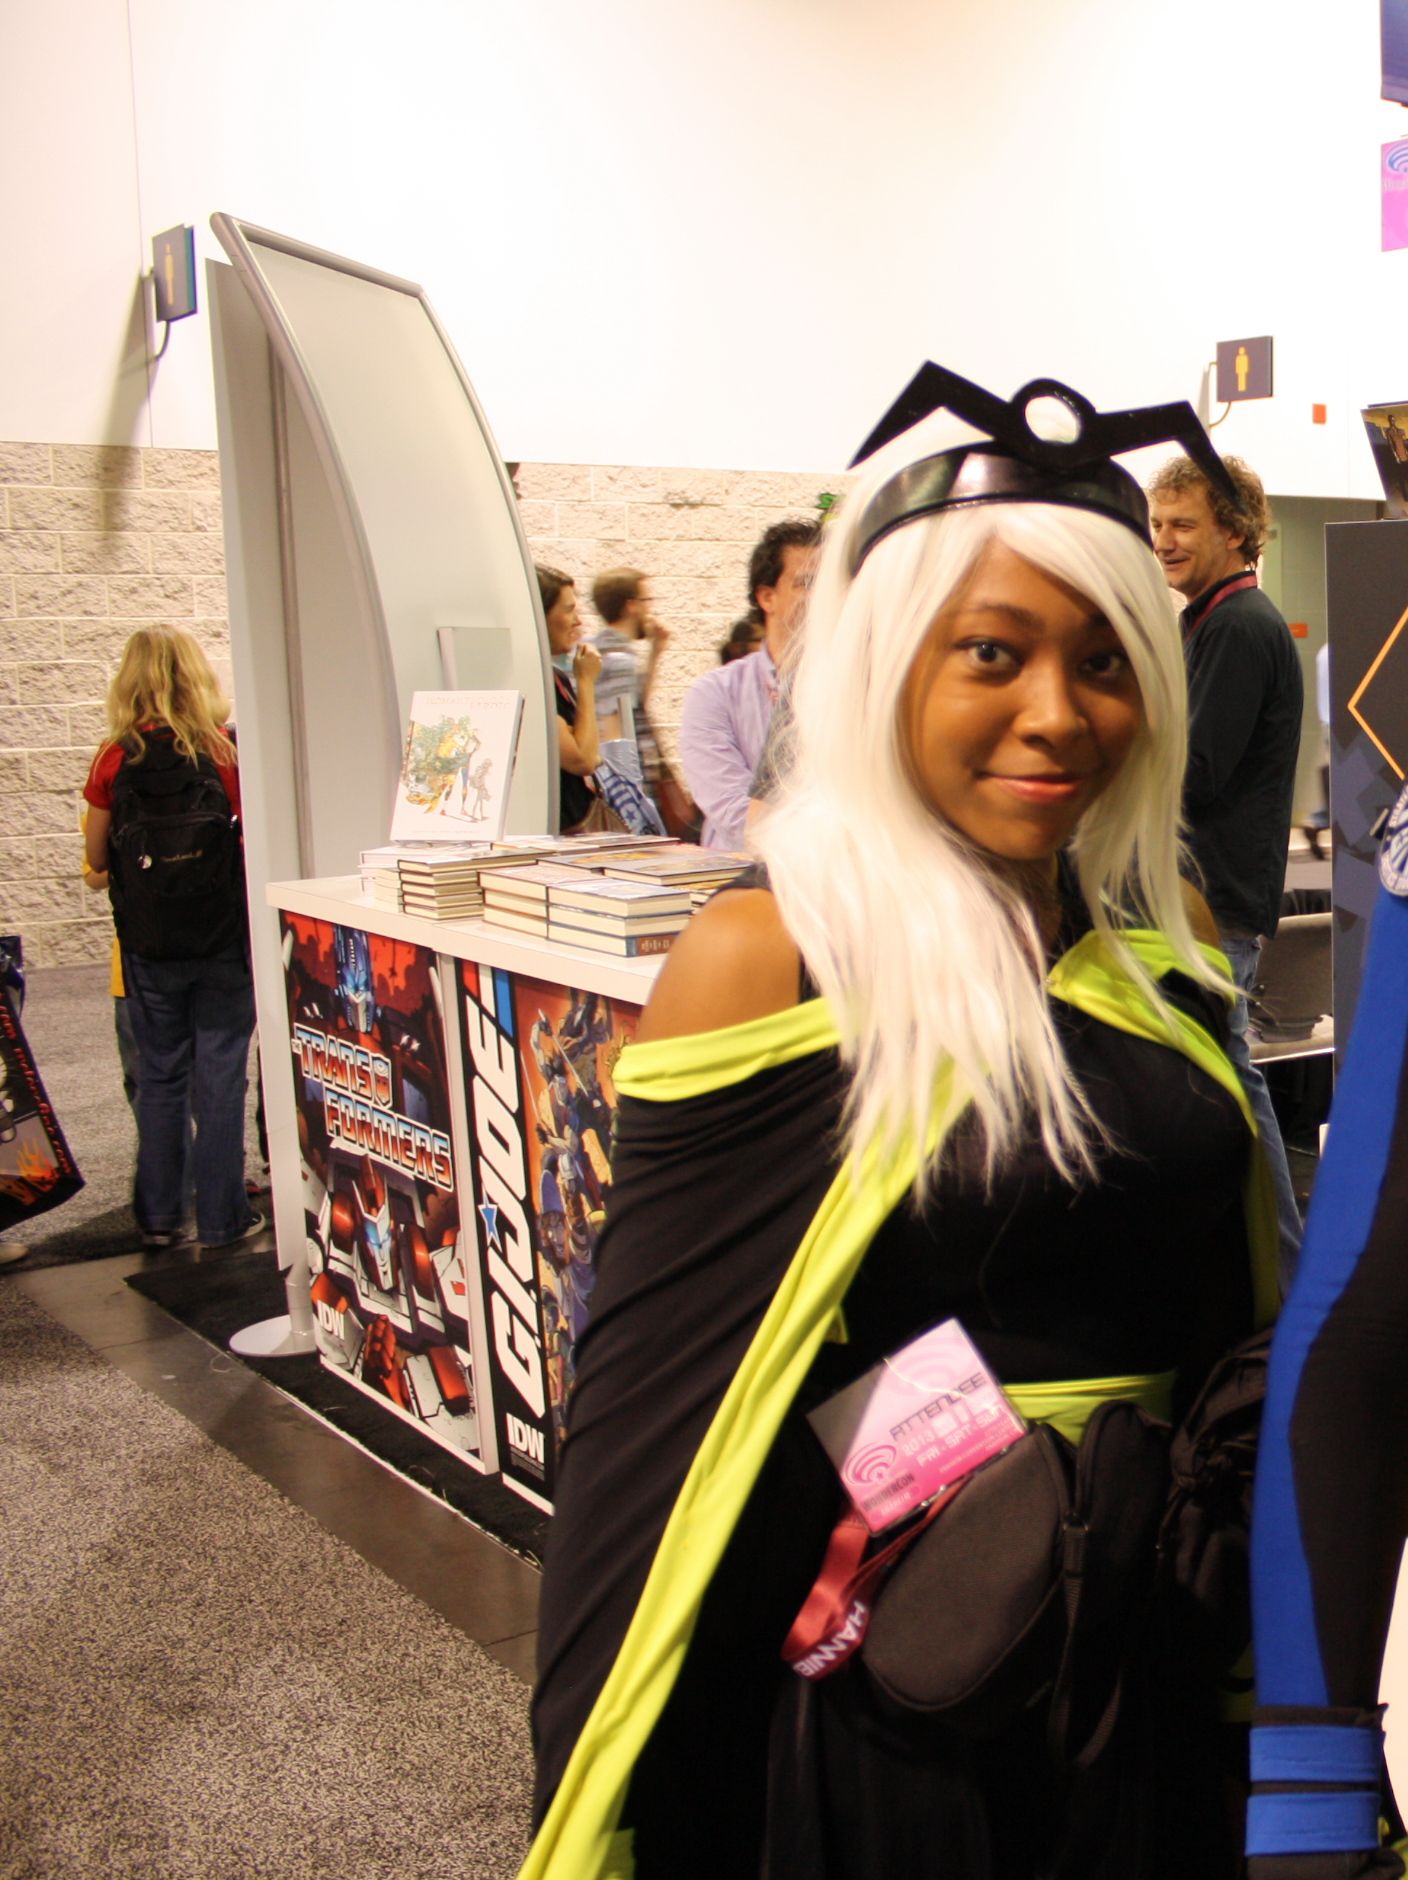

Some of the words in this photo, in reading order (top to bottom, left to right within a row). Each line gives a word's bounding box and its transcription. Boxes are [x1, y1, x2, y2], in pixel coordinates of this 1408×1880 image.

[294, 1022, 374, 1102] TRANS
[323, 1085, 454, 1192] FORMERS
[317, 1299, 345, 1341] IDW
[506, 1412, 545, 1464] IDW
[889, 1371, 986, 1442] ATTENDEE
